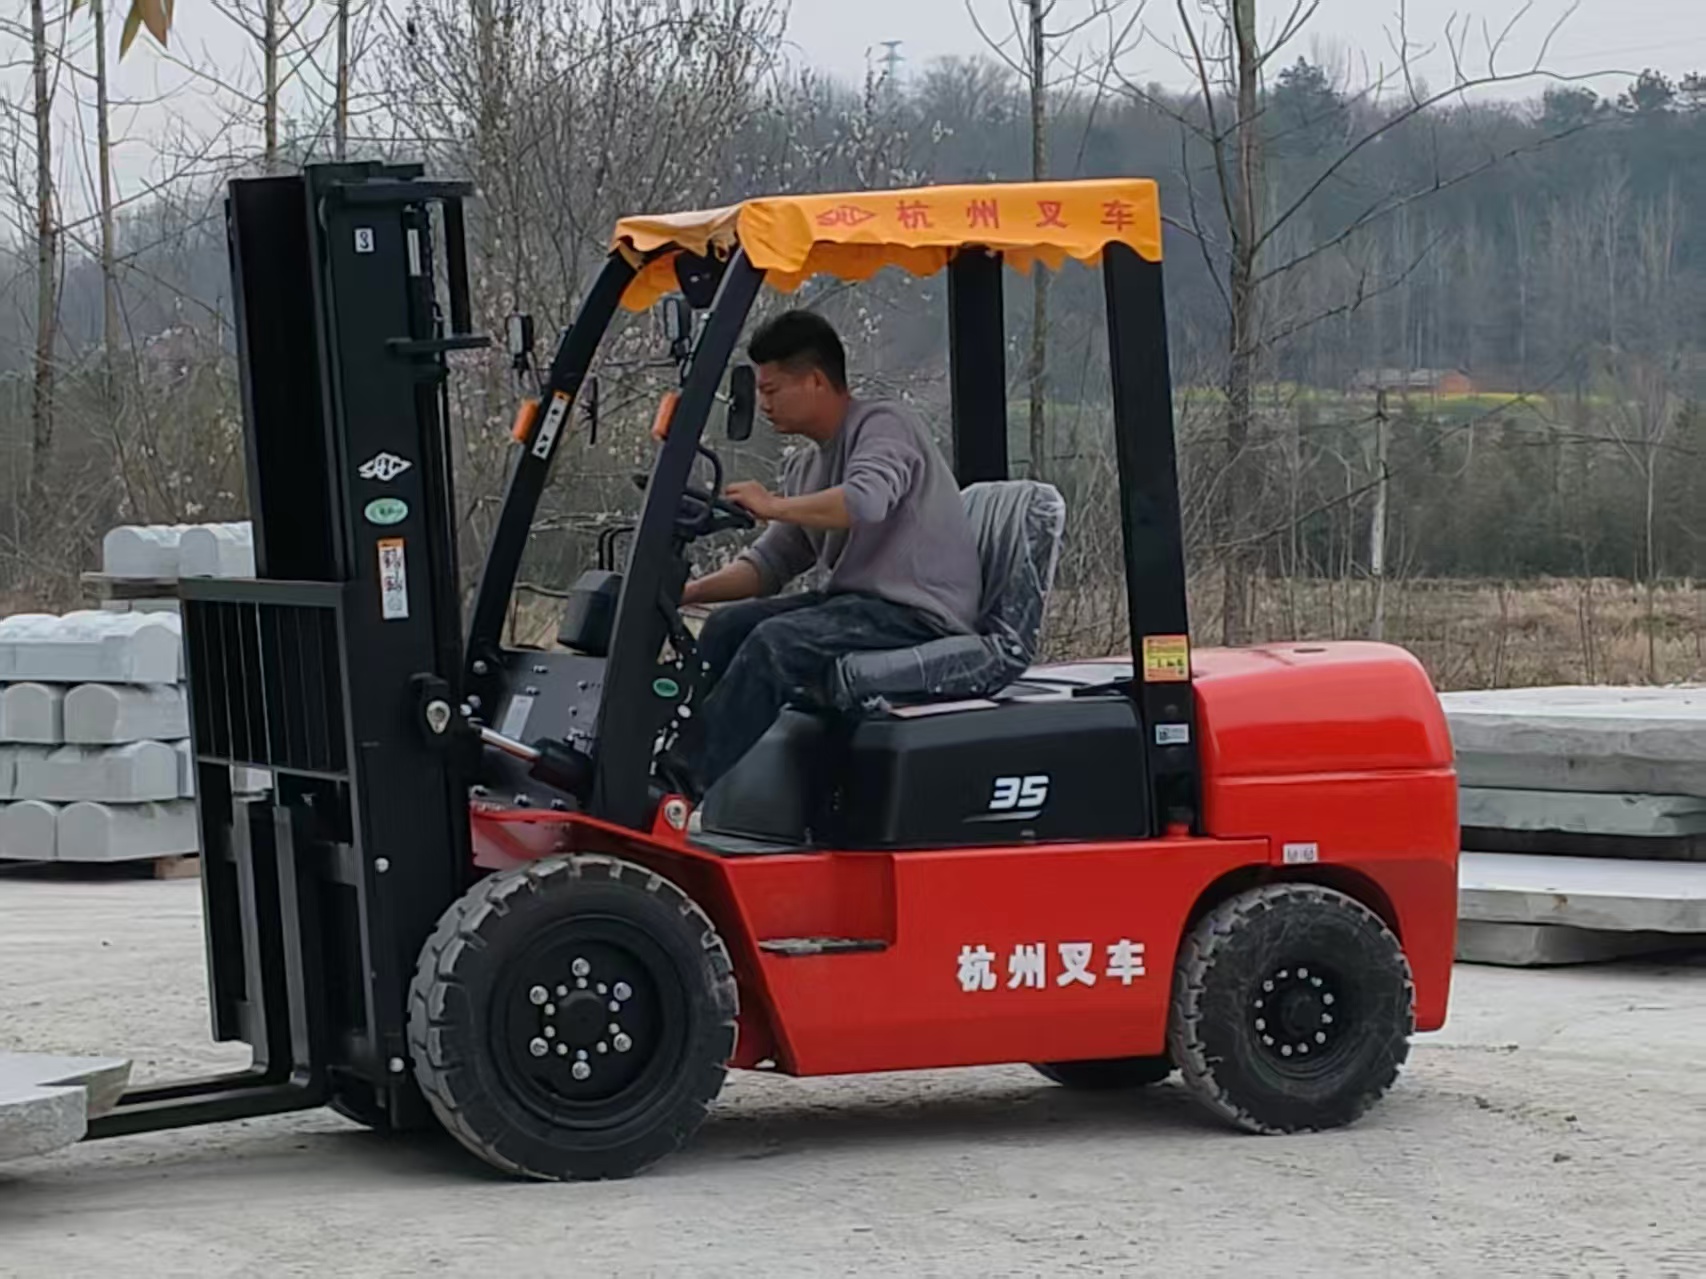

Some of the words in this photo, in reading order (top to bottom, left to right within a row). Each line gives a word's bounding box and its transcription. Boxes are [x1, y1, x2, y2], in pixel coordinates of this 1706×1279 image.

[897, 199, 1135, 231] 杭州叉车
[989, 775, 1049, 809] 35
[957, 939, 1145, 991] 杭州叉车
